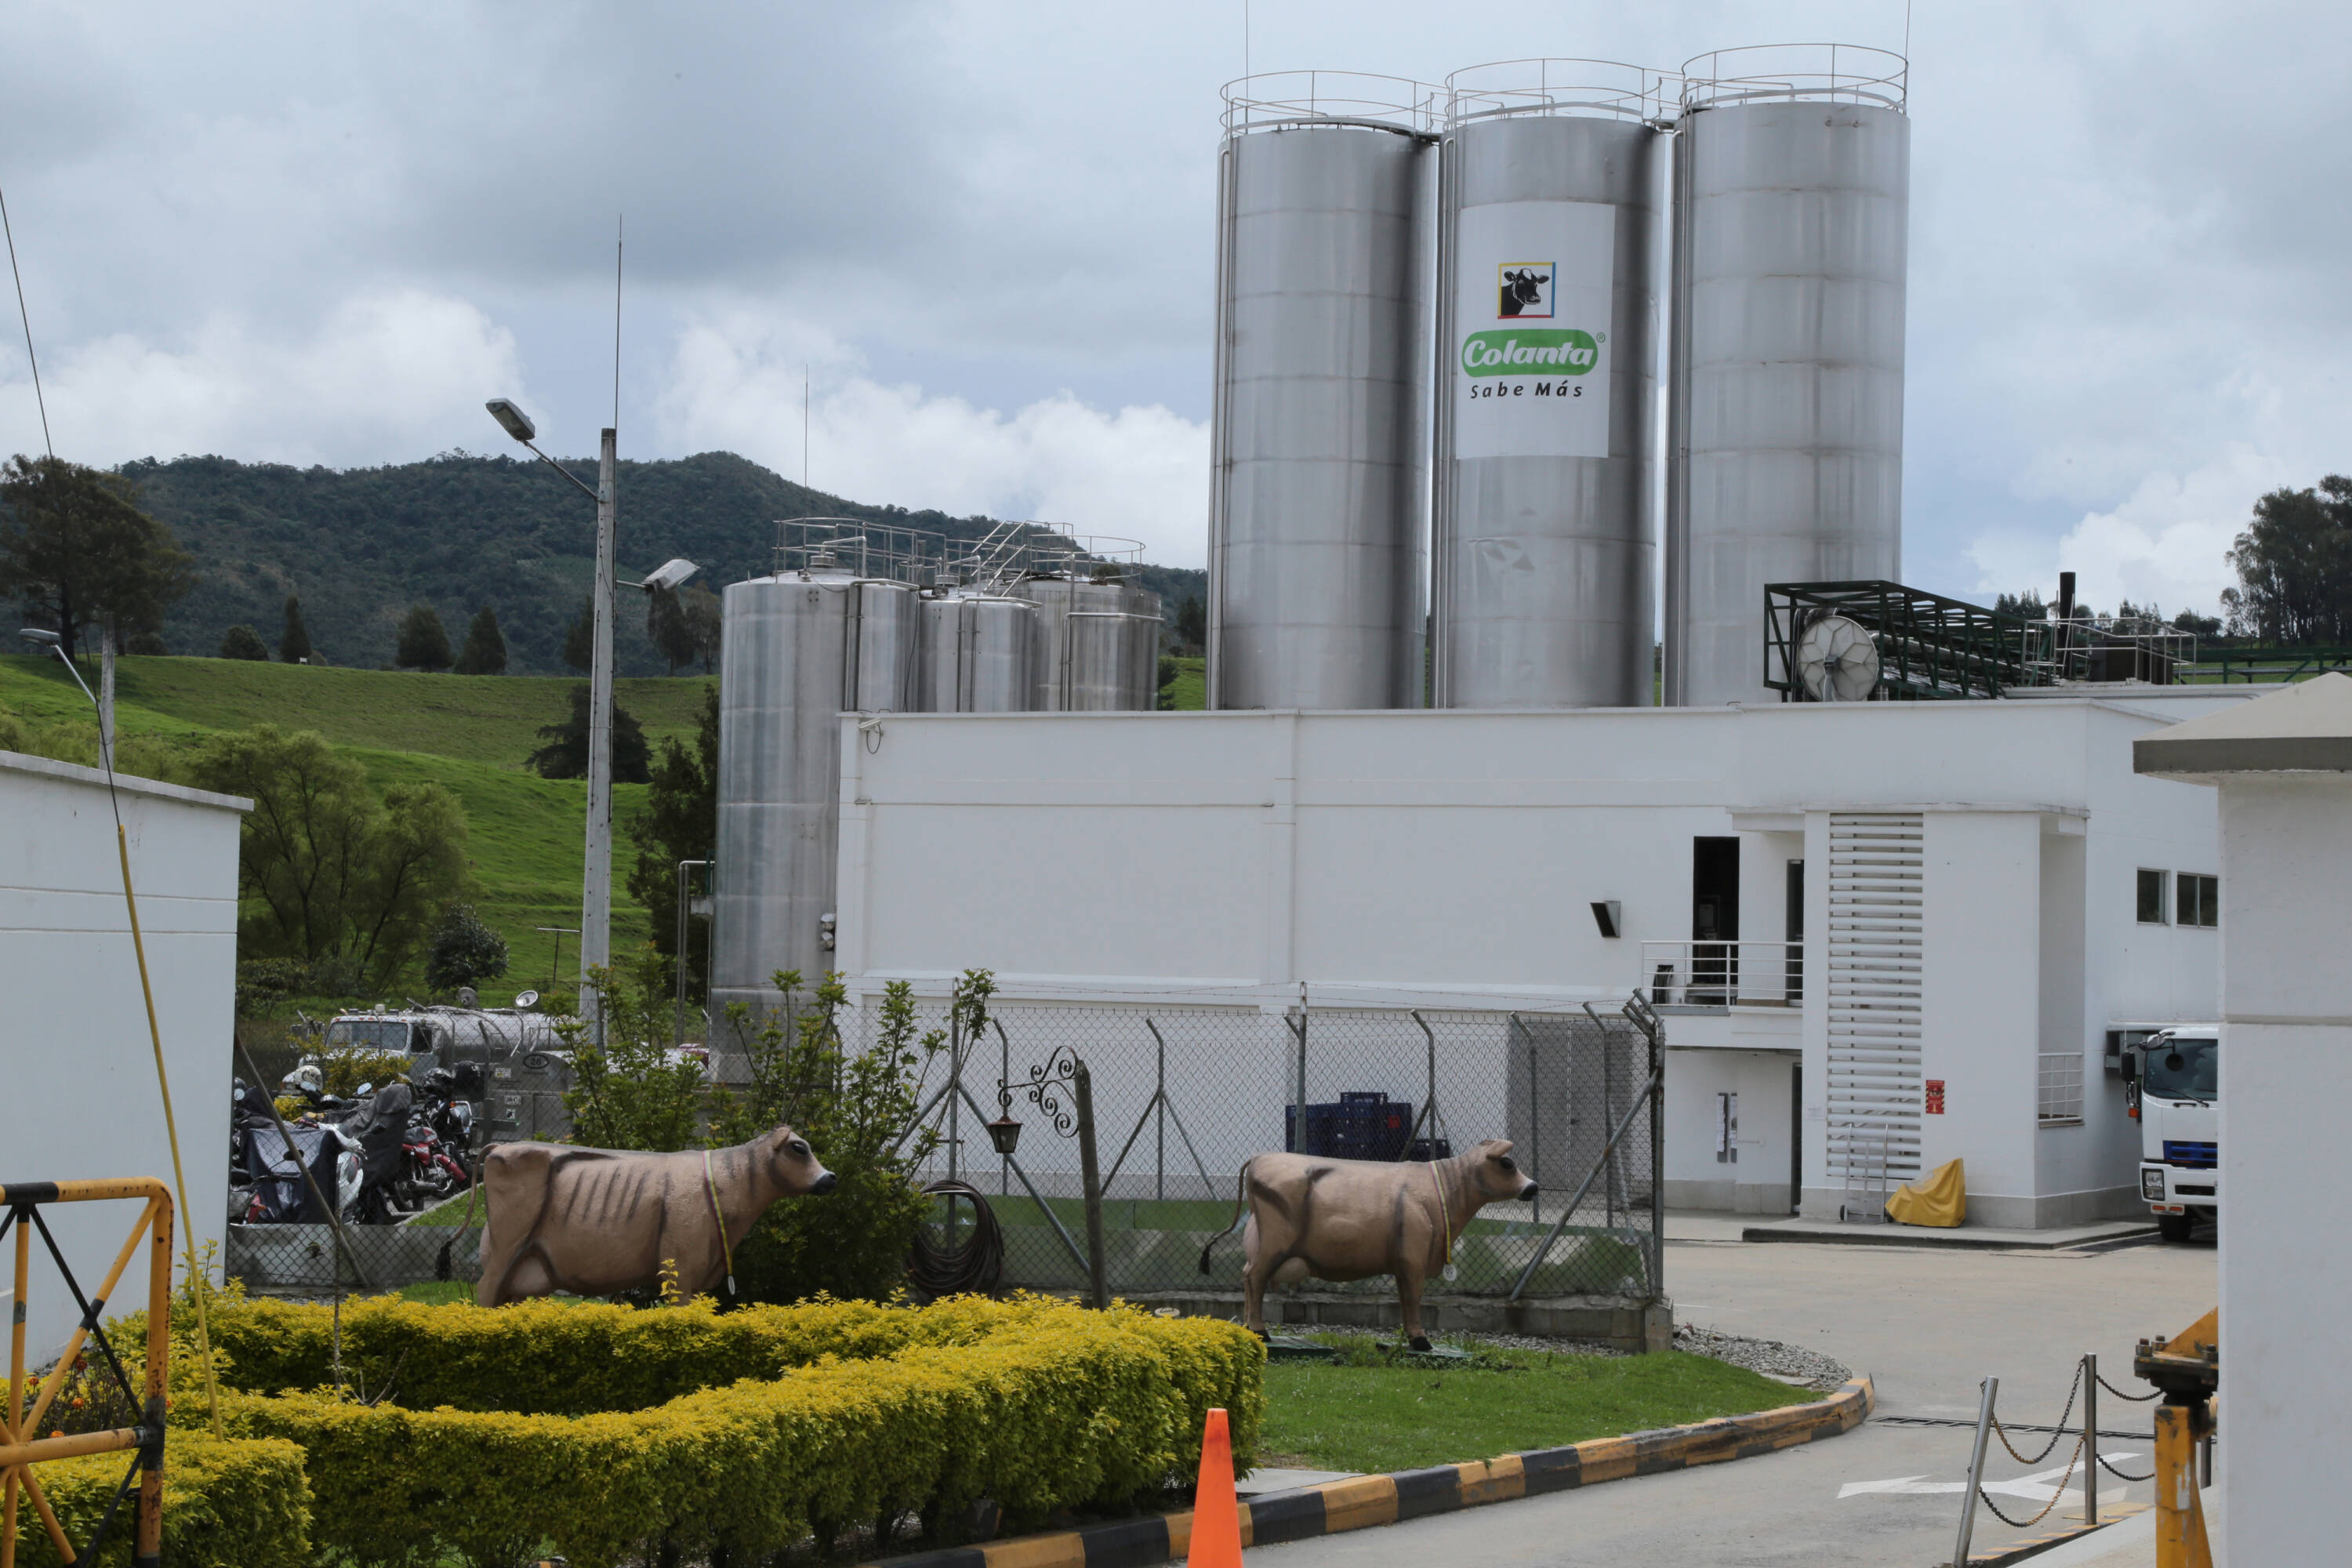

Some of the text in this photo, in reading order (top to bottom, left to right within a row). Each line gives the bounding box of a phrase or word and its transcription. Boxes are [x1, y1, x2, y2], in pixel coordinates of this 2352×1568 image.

[1464, 339, 1594, 367] Colanta
[1471, 380, 1582, 398] Sabe Más
